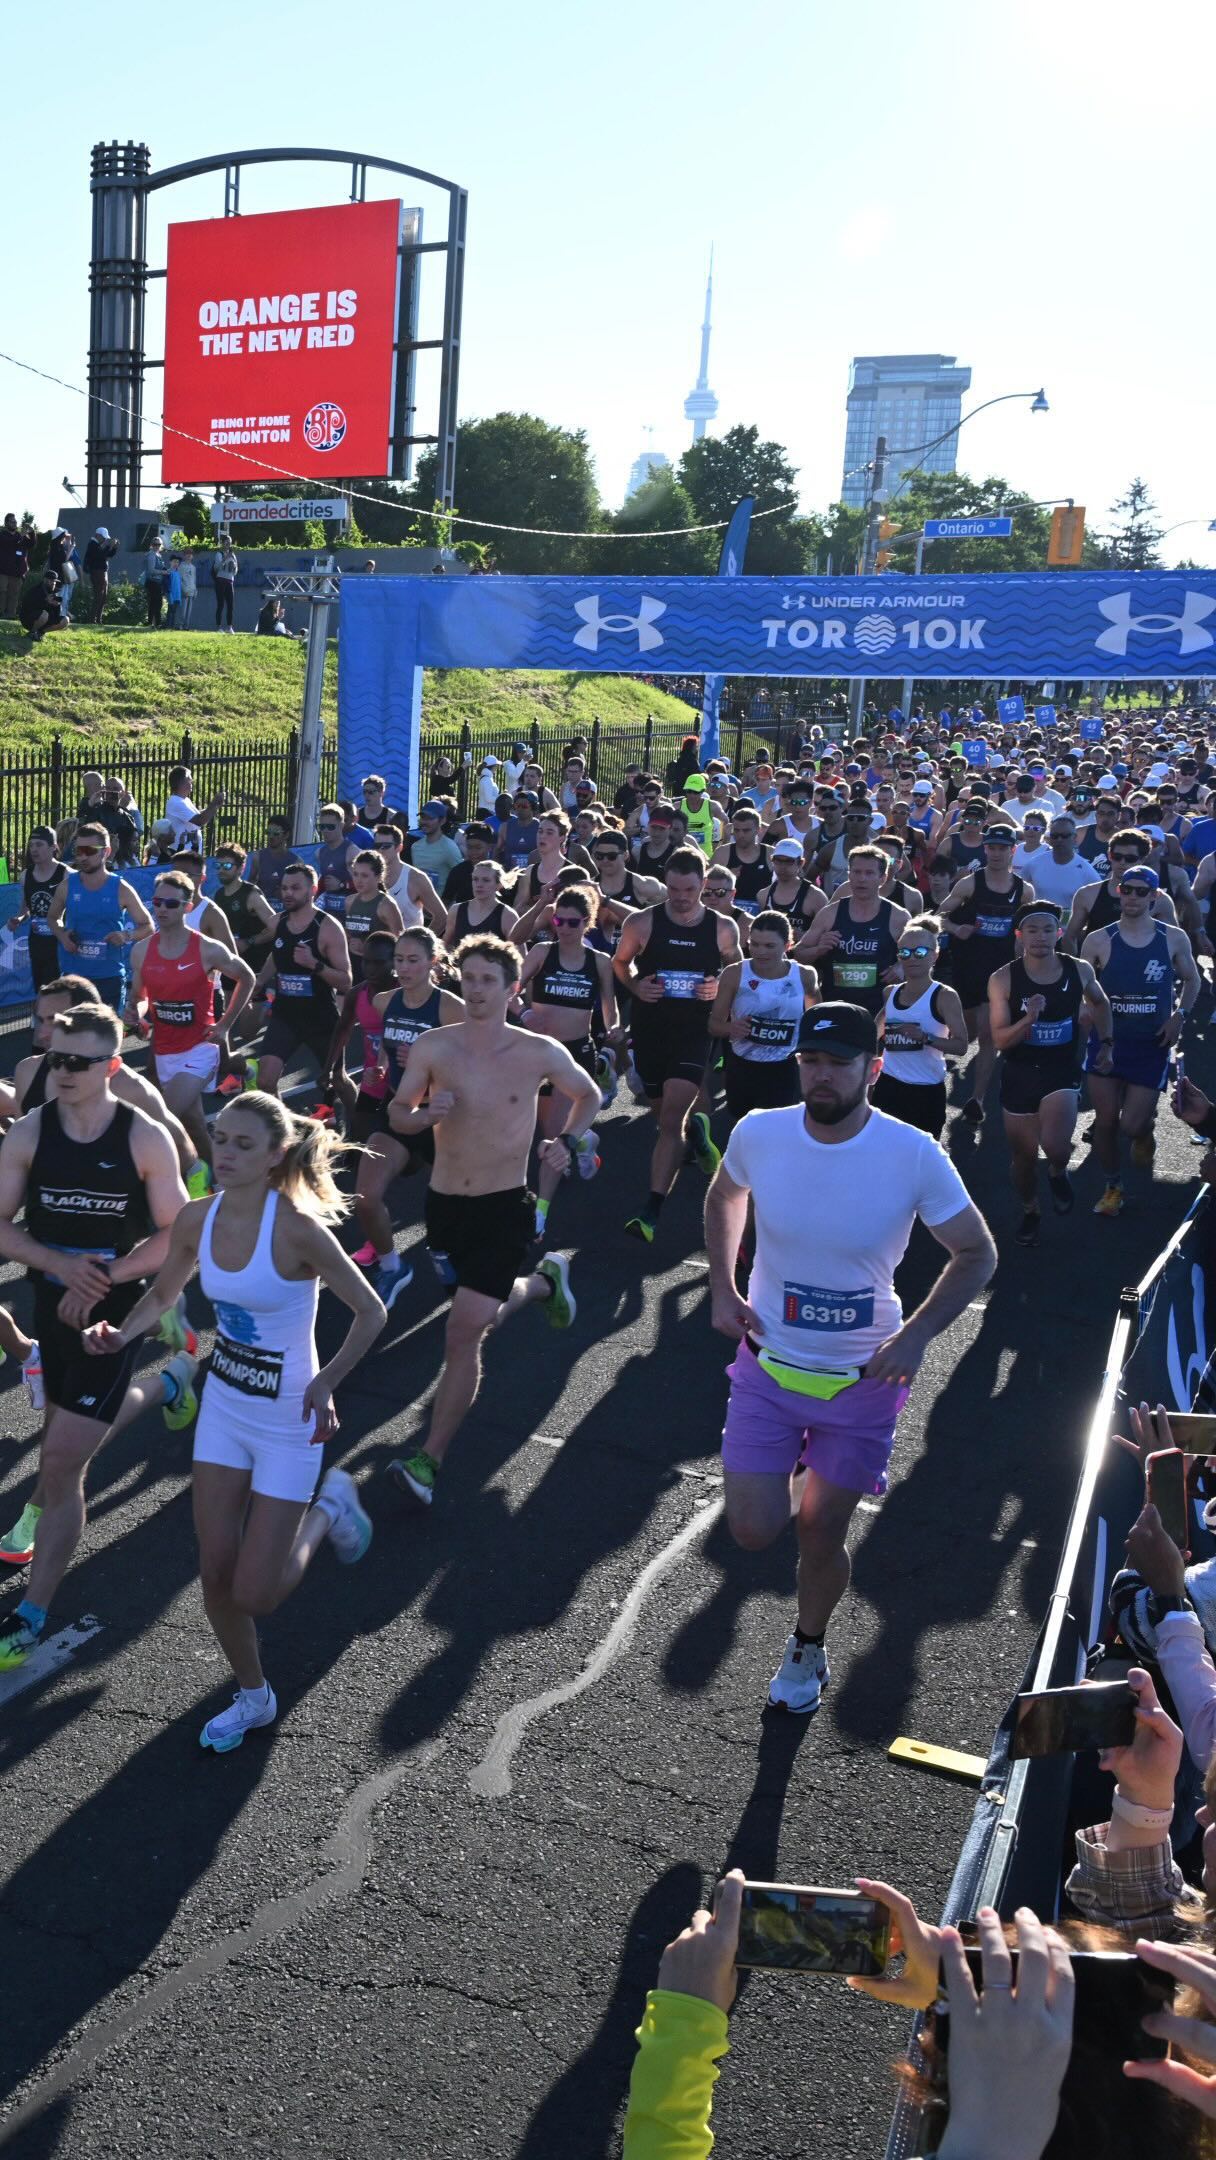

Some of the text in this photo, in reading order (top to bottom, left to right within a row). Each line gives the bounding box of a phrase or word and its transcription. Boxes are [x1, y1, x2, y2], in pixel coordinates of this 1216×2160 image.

[199, 289, 358, 329] ORANGE IS
[199, 324, 355, 356] THE NEW RED
[211, 415, 290, 429] BRING IT HOME
[210, 429, 291, 446] EDMONTON
[223, 502, 333, 520] brandedcities
[938, 520, 997, 535] Ontario Dr
[812, 595, 965, 608] UNDER ARMOUR
[762, 618, 987, 650] TOR 10K
[1005, 701, 1017, 710] 40
[841, 970, 869, 981] 1290
[280, 980, 304, 991] 5162
[545, 983, 591, 998] LAWRENCE
[664, 979, 696, 991] 3936
[1111, 1002, 1157, 1013] FOURNIER
[156, 1009, 193, 1021] BIRCH
[384, 1026, 419, 1043] MURRA
[750, 1026, 788, 1040] LEON
[885, 1033, 922, 1045] RYNA
[1036, 1028, 1063, 1039] 1117
[40, 1192, 128, 1212] BLACKTOE
[801, 1304, 857, 1324] 6319
[211, 1348, 279, 1391] THOMPSON
